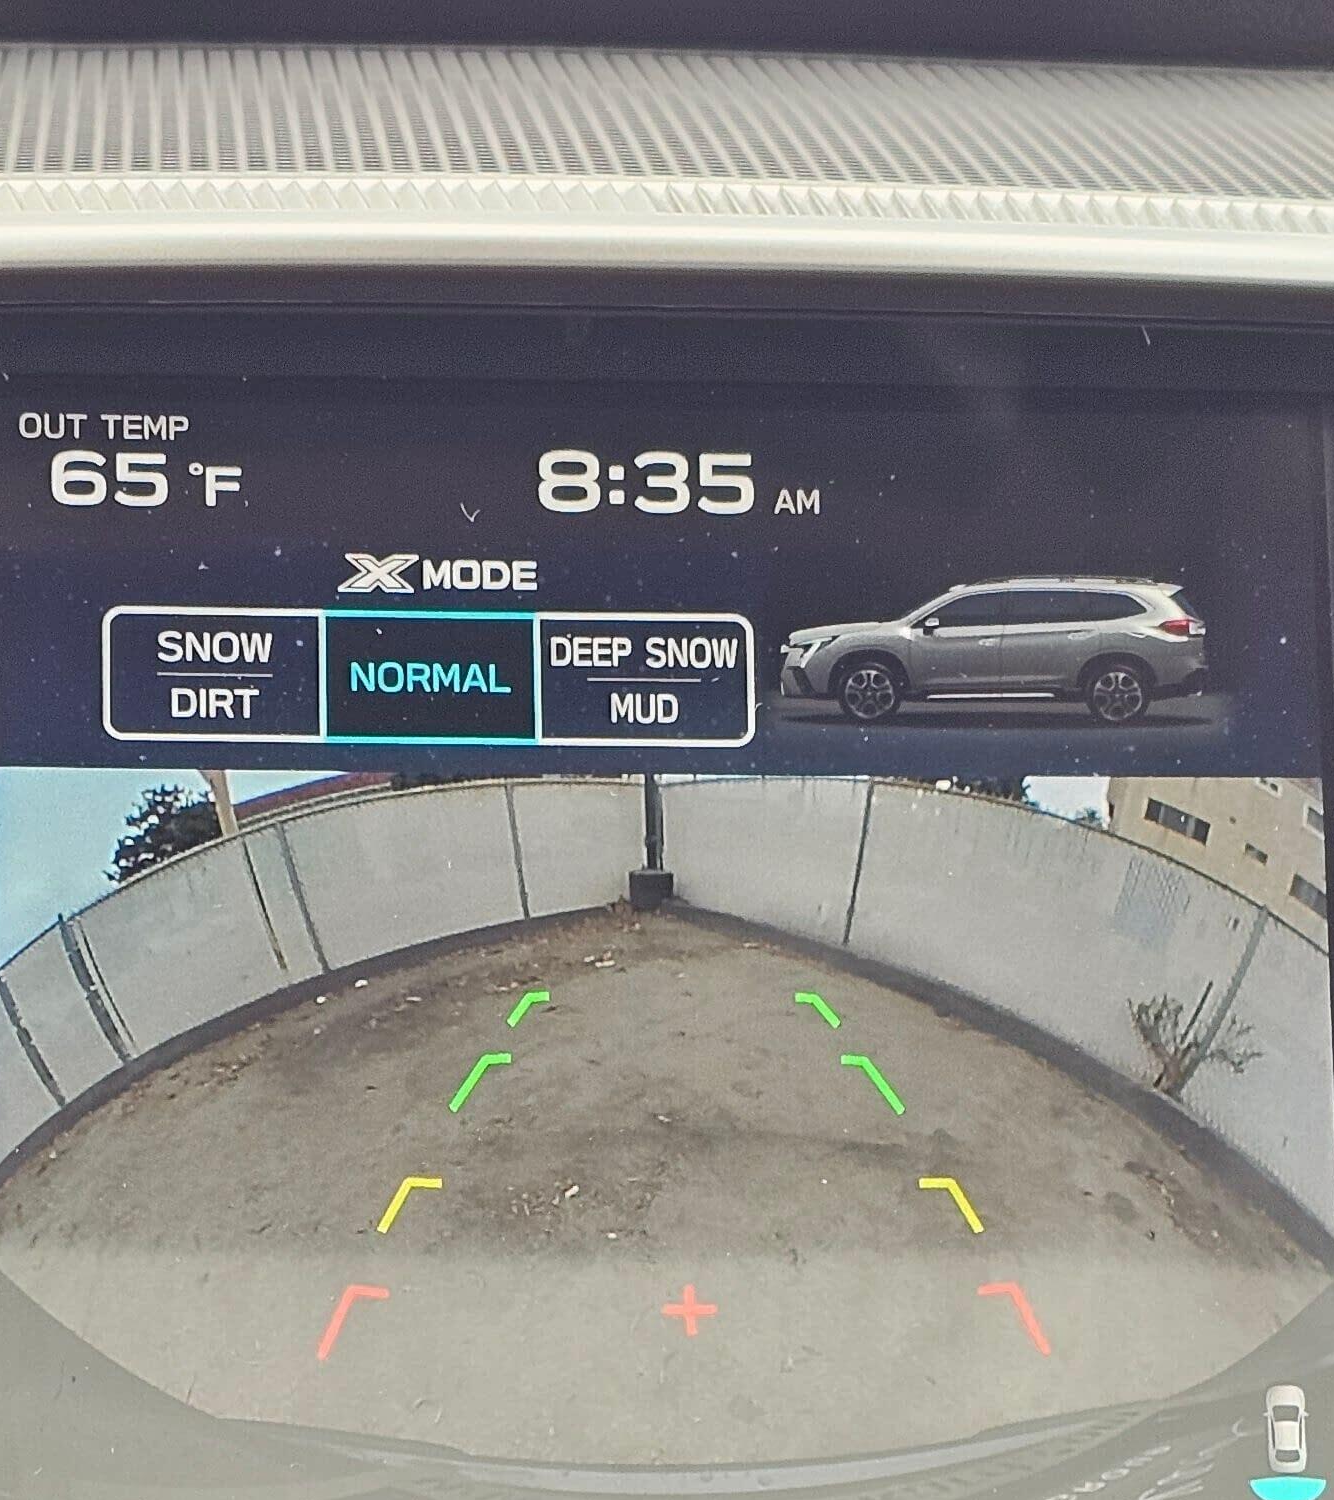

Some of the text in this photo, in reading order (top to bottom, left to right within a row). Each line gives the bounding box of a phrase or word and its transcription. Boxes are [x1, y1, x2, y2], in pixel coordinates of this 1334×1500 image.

[19, 413, 190, 441] OUT TEMP
[50, 450, 169, 507] 65
[537, 452, 821, 515] 8:35 AM
[157, 632, 274, 664] SNOW
[550, 636, 739, 669] DEEP SNOW
[349, 661, 512, 694] NORMAL
[169, 689, 259, 719] DIRT
[610, 693, 680, 724] MUD
